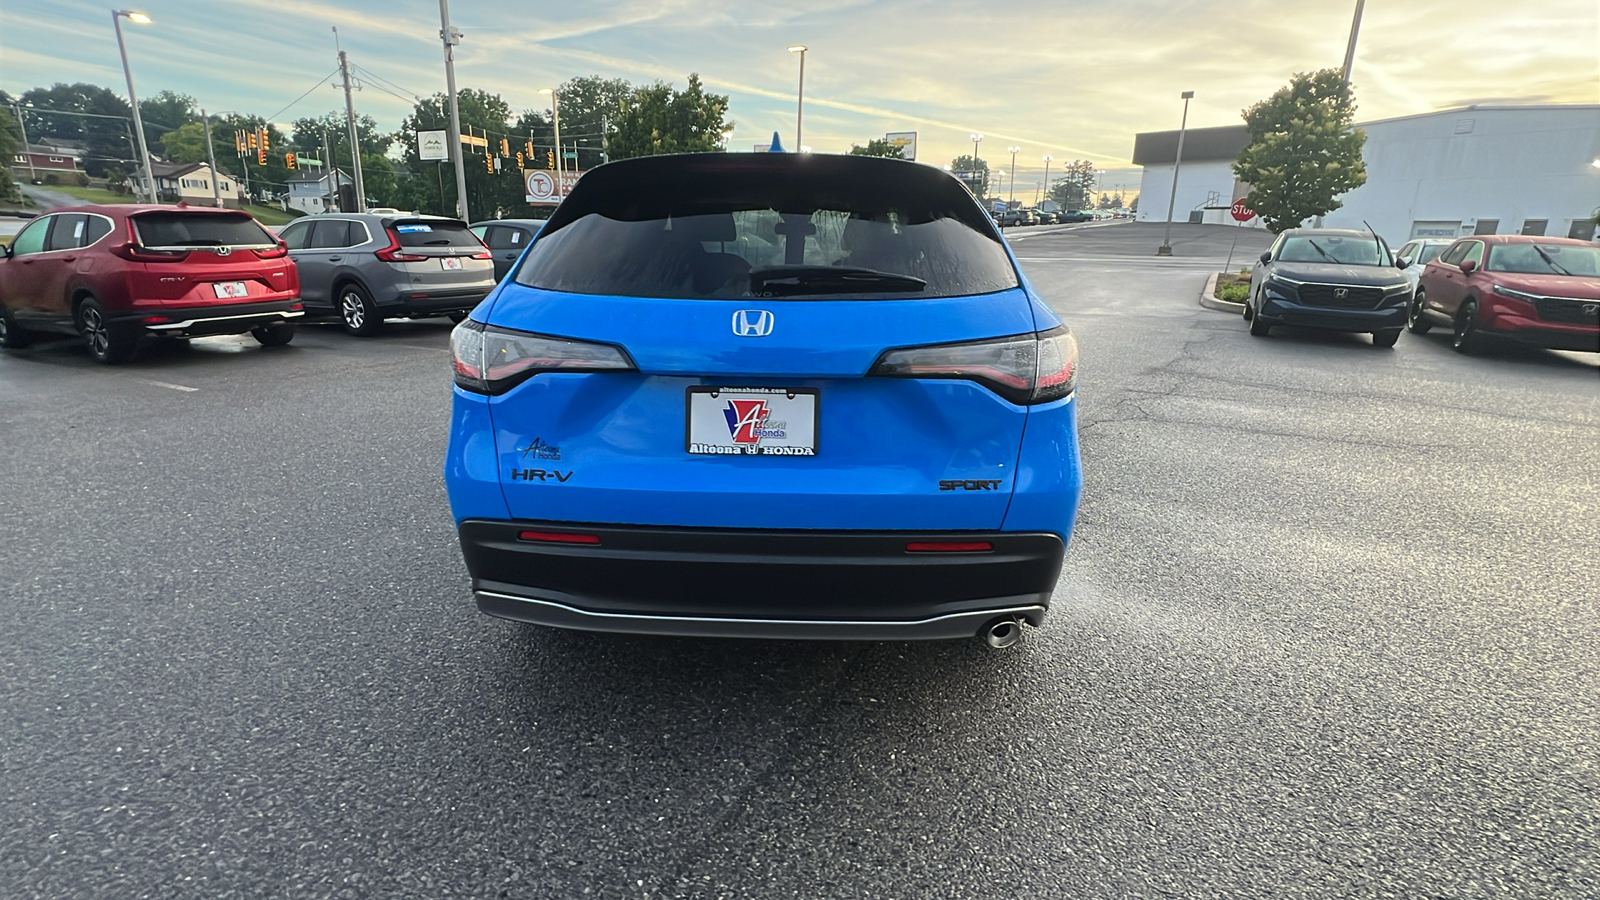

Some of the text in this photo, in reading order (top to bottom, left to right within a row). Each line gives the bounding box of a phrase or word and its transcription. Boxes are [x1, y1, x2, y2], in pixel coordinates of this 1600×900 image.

[754, 429, 785, 438] Honda
[689, 443, 815, 456] Altoona HONDA
[511, 469, 573, 482] HR-V
[939, 479, 1002, 490] SPORT
